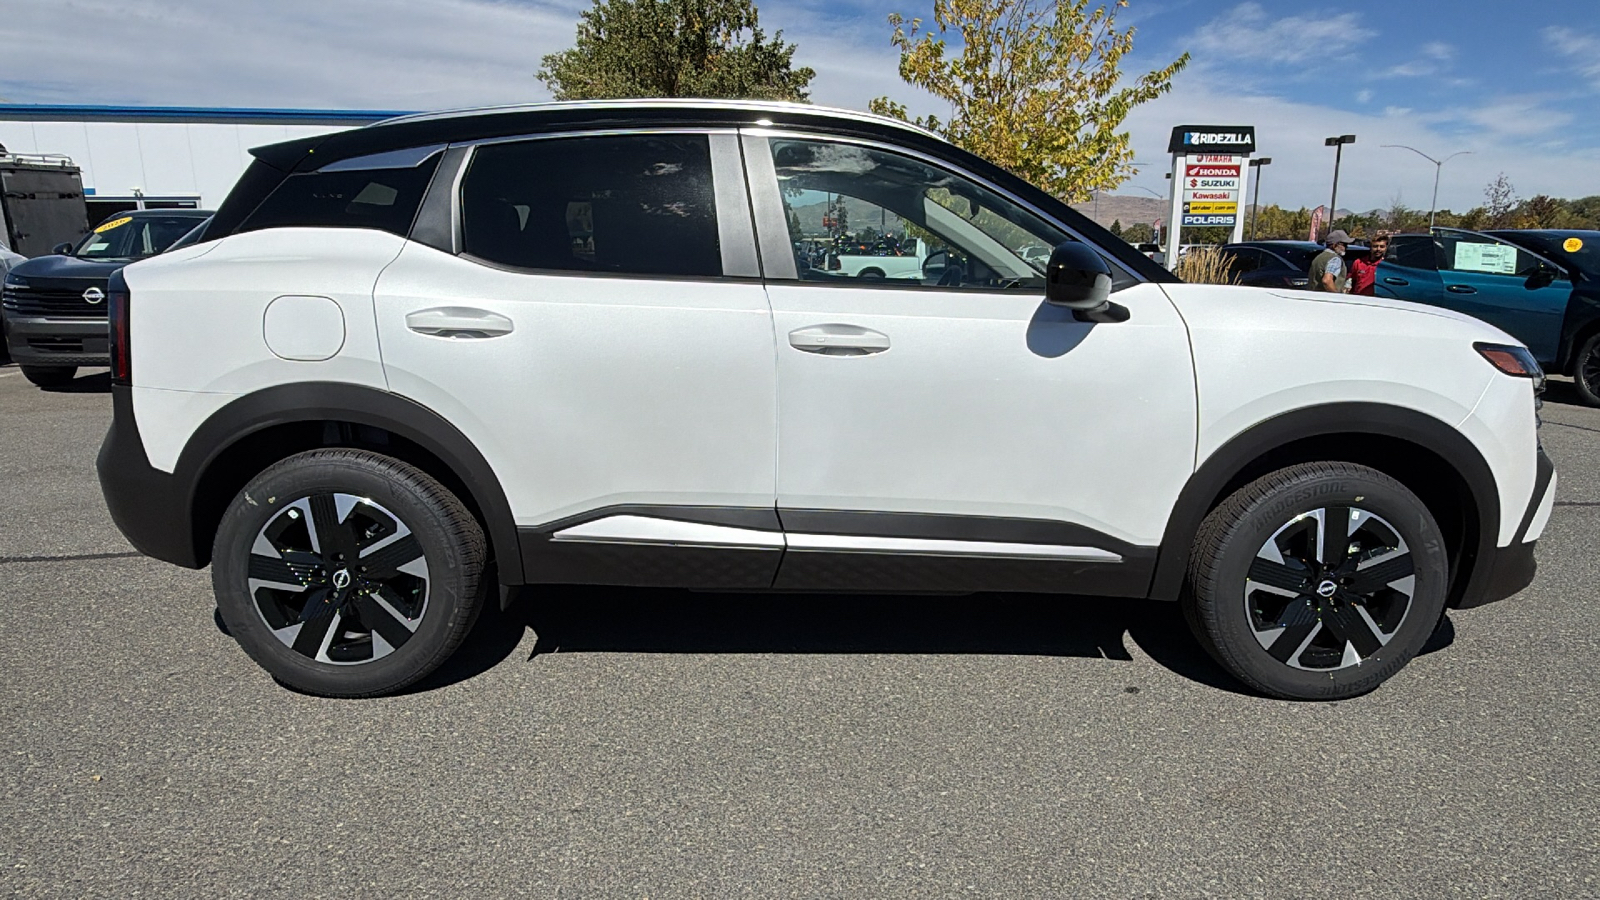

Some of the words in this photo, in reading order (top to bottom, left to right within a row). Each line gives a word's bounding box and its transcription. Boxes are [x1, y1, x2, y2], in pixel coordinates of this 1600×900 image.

[1200, 133, 1252, 144] RIDEZILLA
[1184, 216, 1233, 224] POLARIS
[1253, 481, 1348, 533] BRIDGESTONE
